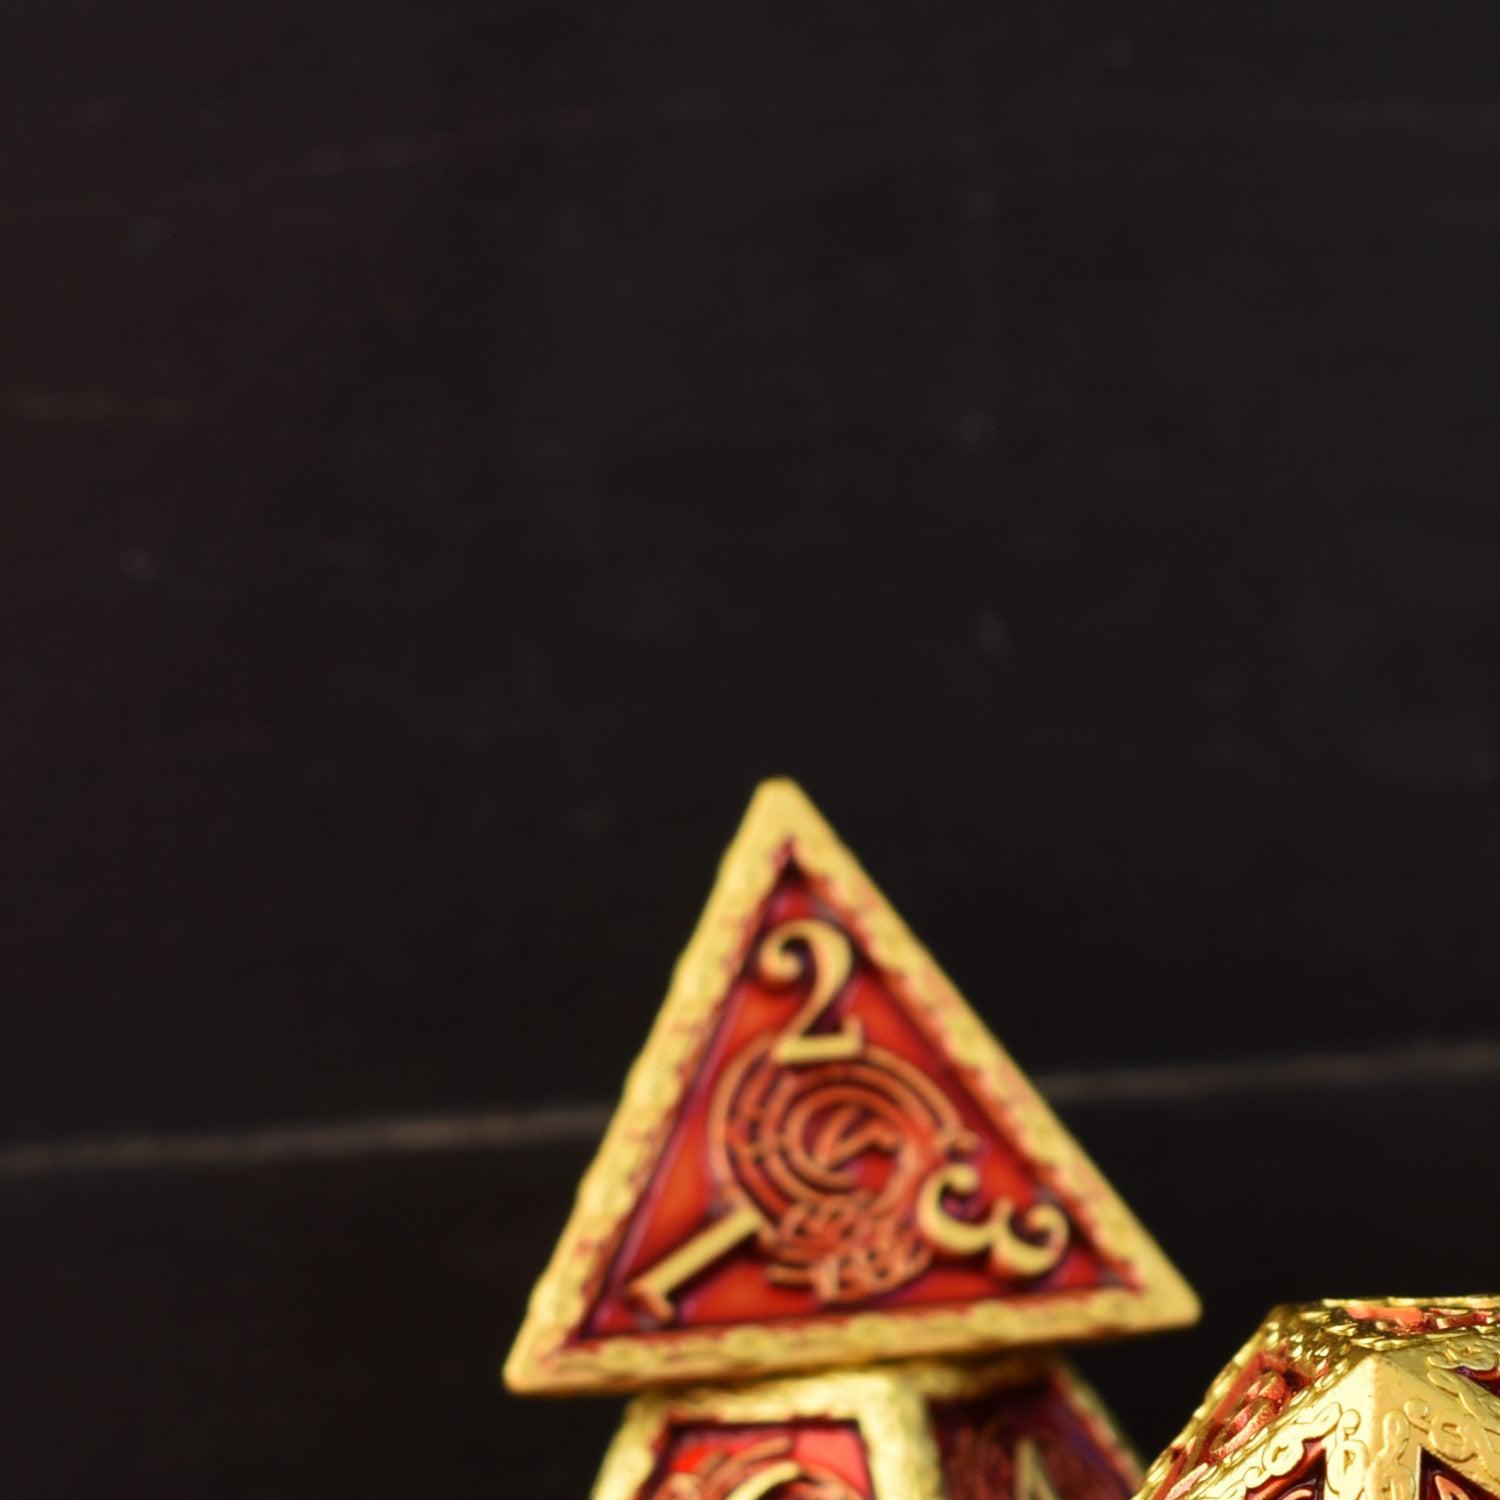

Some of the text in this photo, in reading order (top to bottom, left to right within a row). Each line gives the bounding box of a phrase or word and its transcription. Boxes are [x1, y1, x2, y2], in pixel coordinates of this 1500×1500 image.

[758, 919, 863, 1063] 2
[628, 1207, 764, 1323] 1
[919, 1165, 1069, 1276] 3
